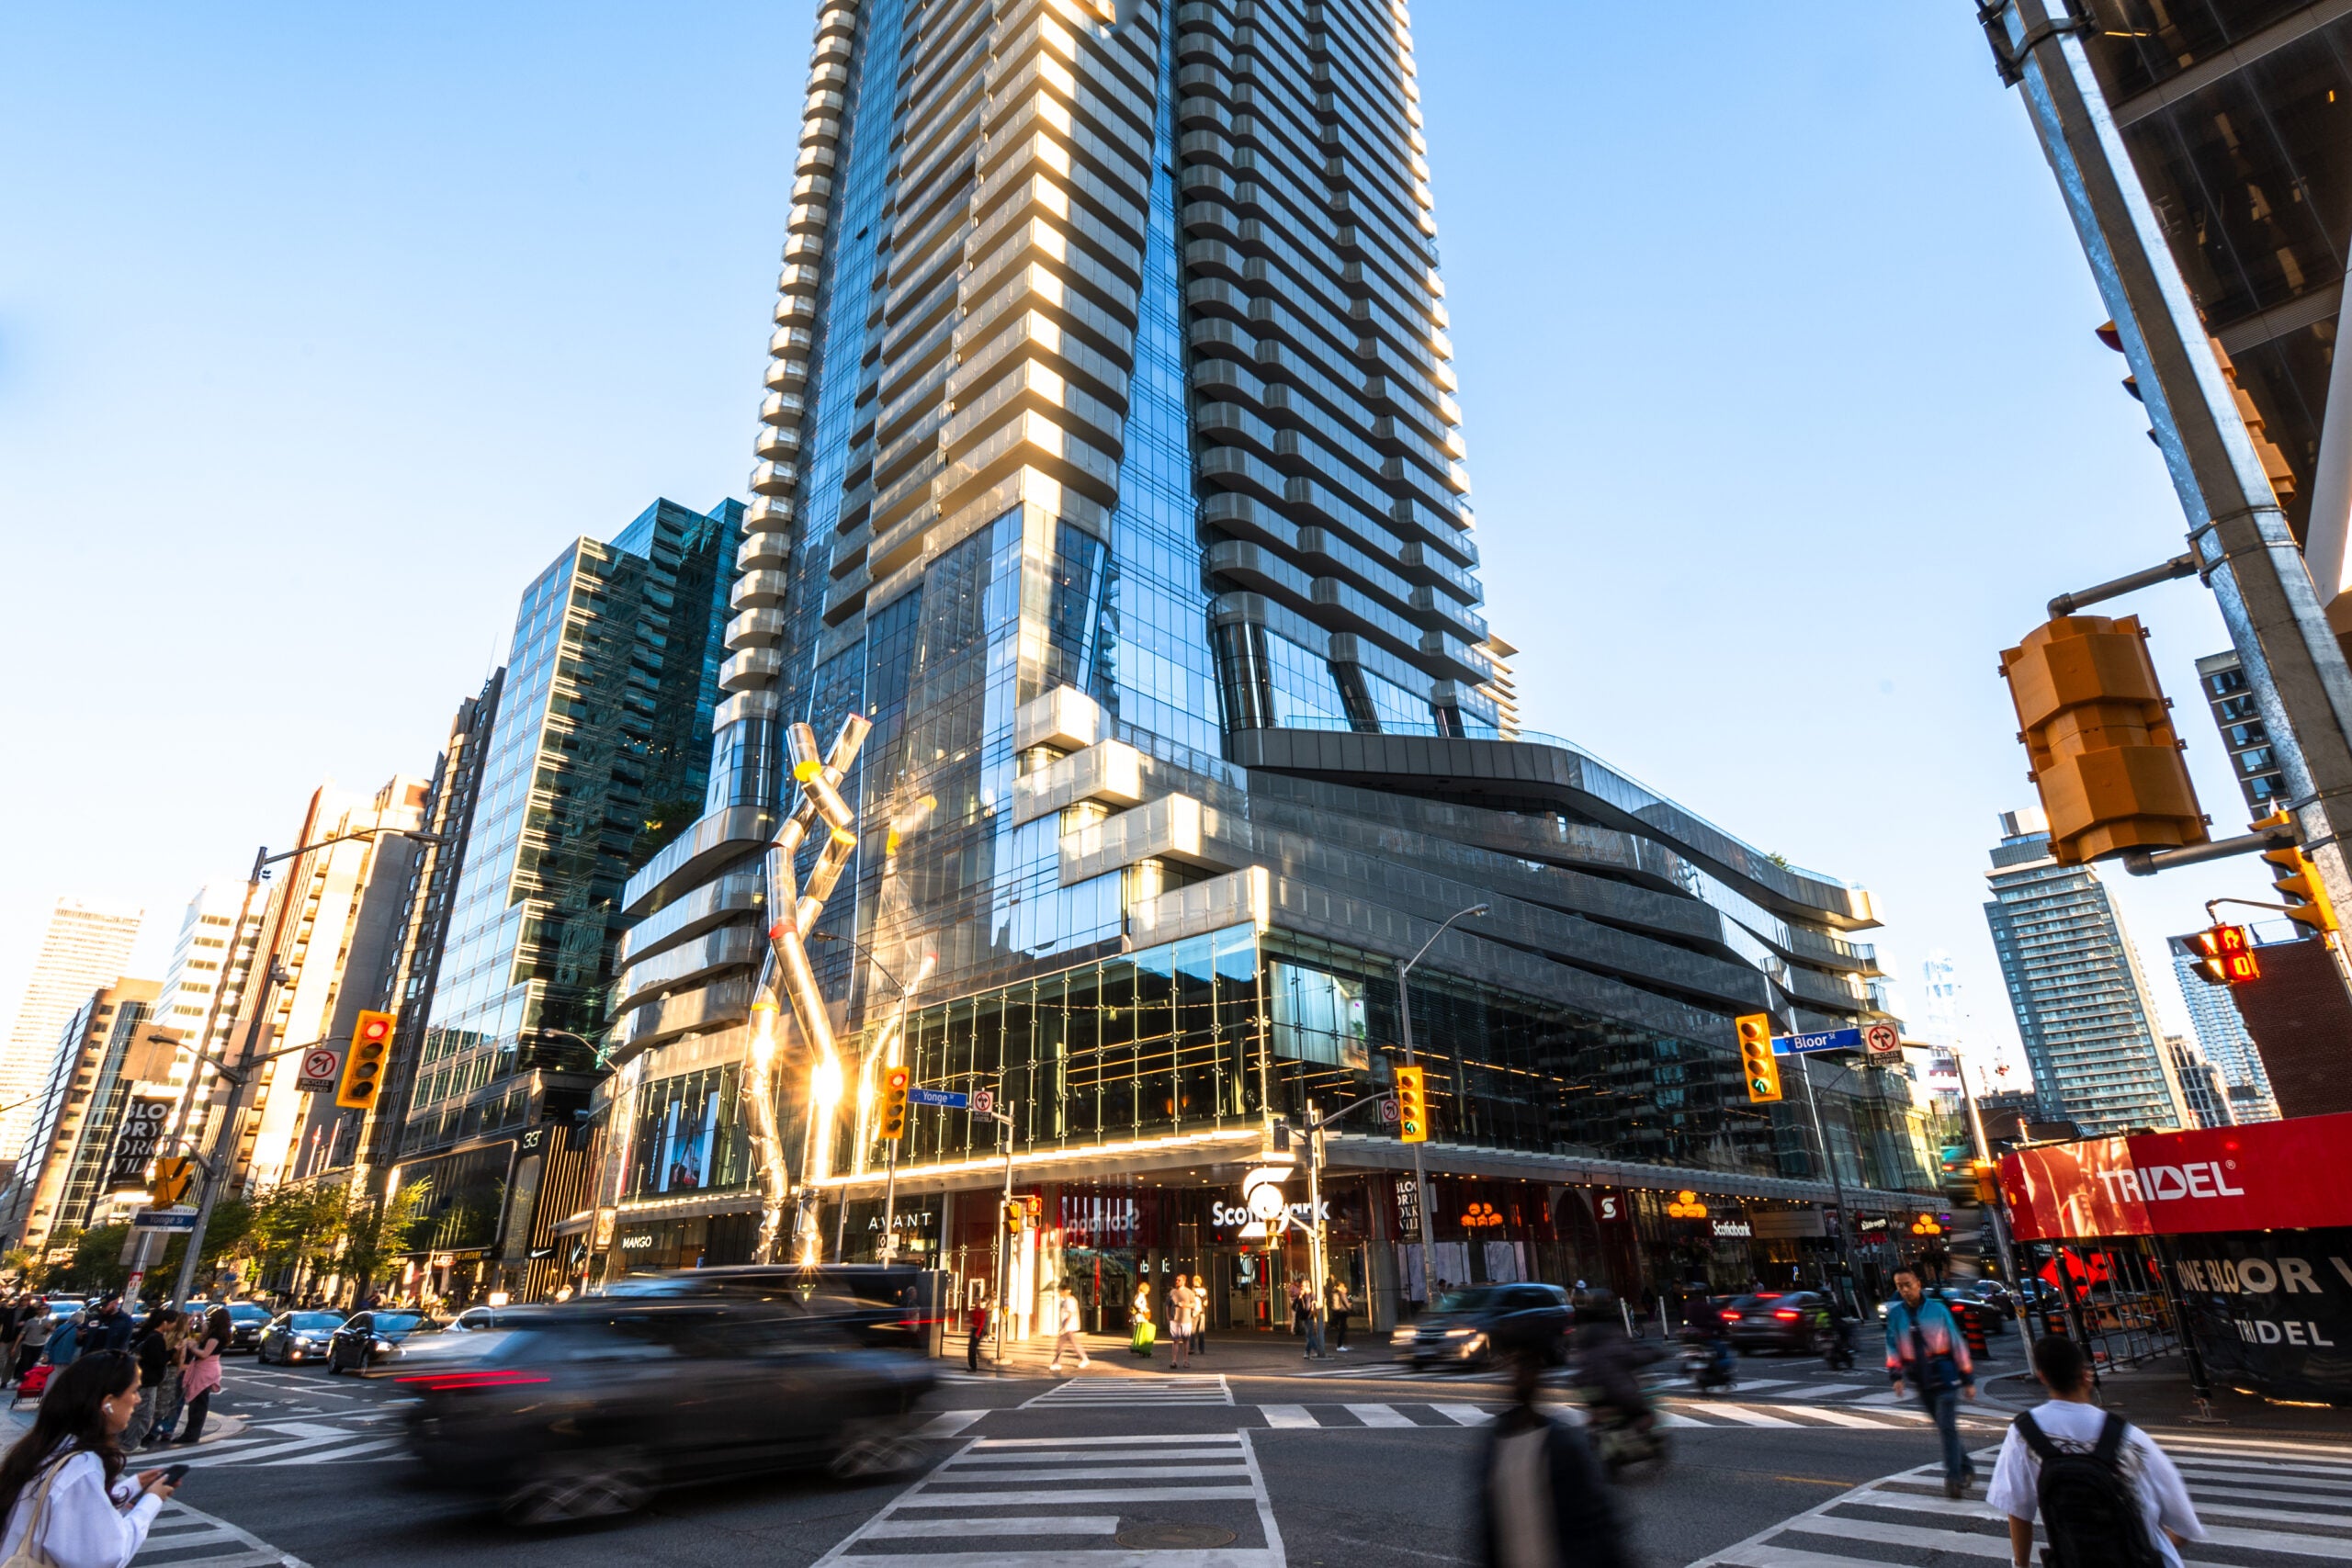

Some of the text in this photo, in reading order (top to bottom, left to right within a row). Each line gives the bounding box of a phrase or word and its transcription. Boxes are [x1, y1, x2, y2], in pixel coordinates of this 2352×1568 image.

[1794, 1036, 1827, 1049] Bloor
[922, 1090, 948, 1105] Yonge
[1713, 1220, 1752, 1236] Scotiabank
[622, 1235, 652, 1249] MANGO
[2176, 1259, 2209, 1292] ONE
[2205, 1257, 2324, 1294] BLOOR
[2234, 1318, 2335, 1347] TRIDEL
